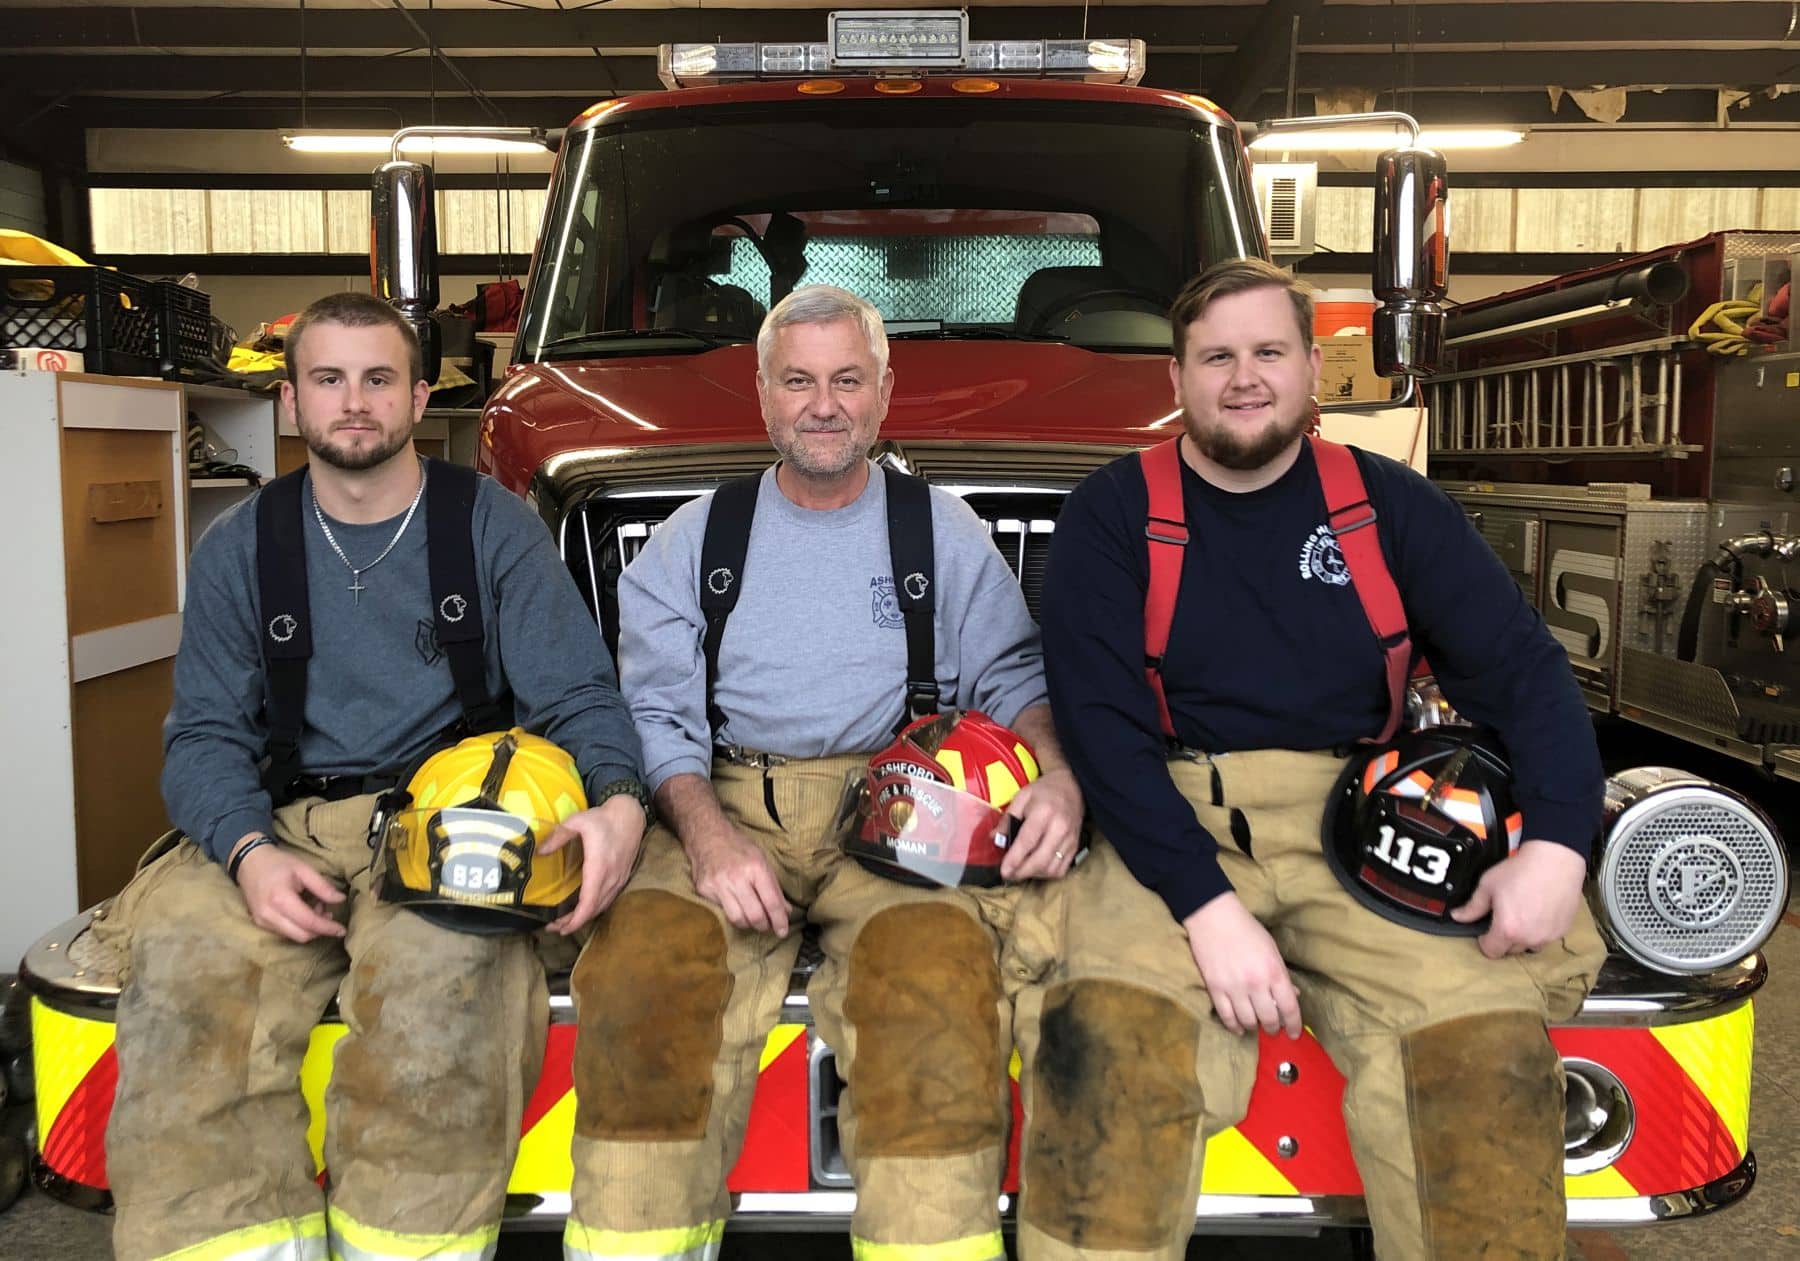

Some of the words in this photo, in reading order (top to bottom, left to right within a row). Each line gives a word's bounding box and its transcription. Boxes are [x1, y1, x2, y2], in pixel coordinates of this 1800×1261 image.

[1299, 534, 1319, 579] ROLLING
[870, 575, 894, 588] ASH
[880, 762, 935, 782] ASHFORD
[903, 784, 943, 817] RESCUE
[886, 836, 927, 855] MOMAN
[1373, 824, 1451, 886] 113
